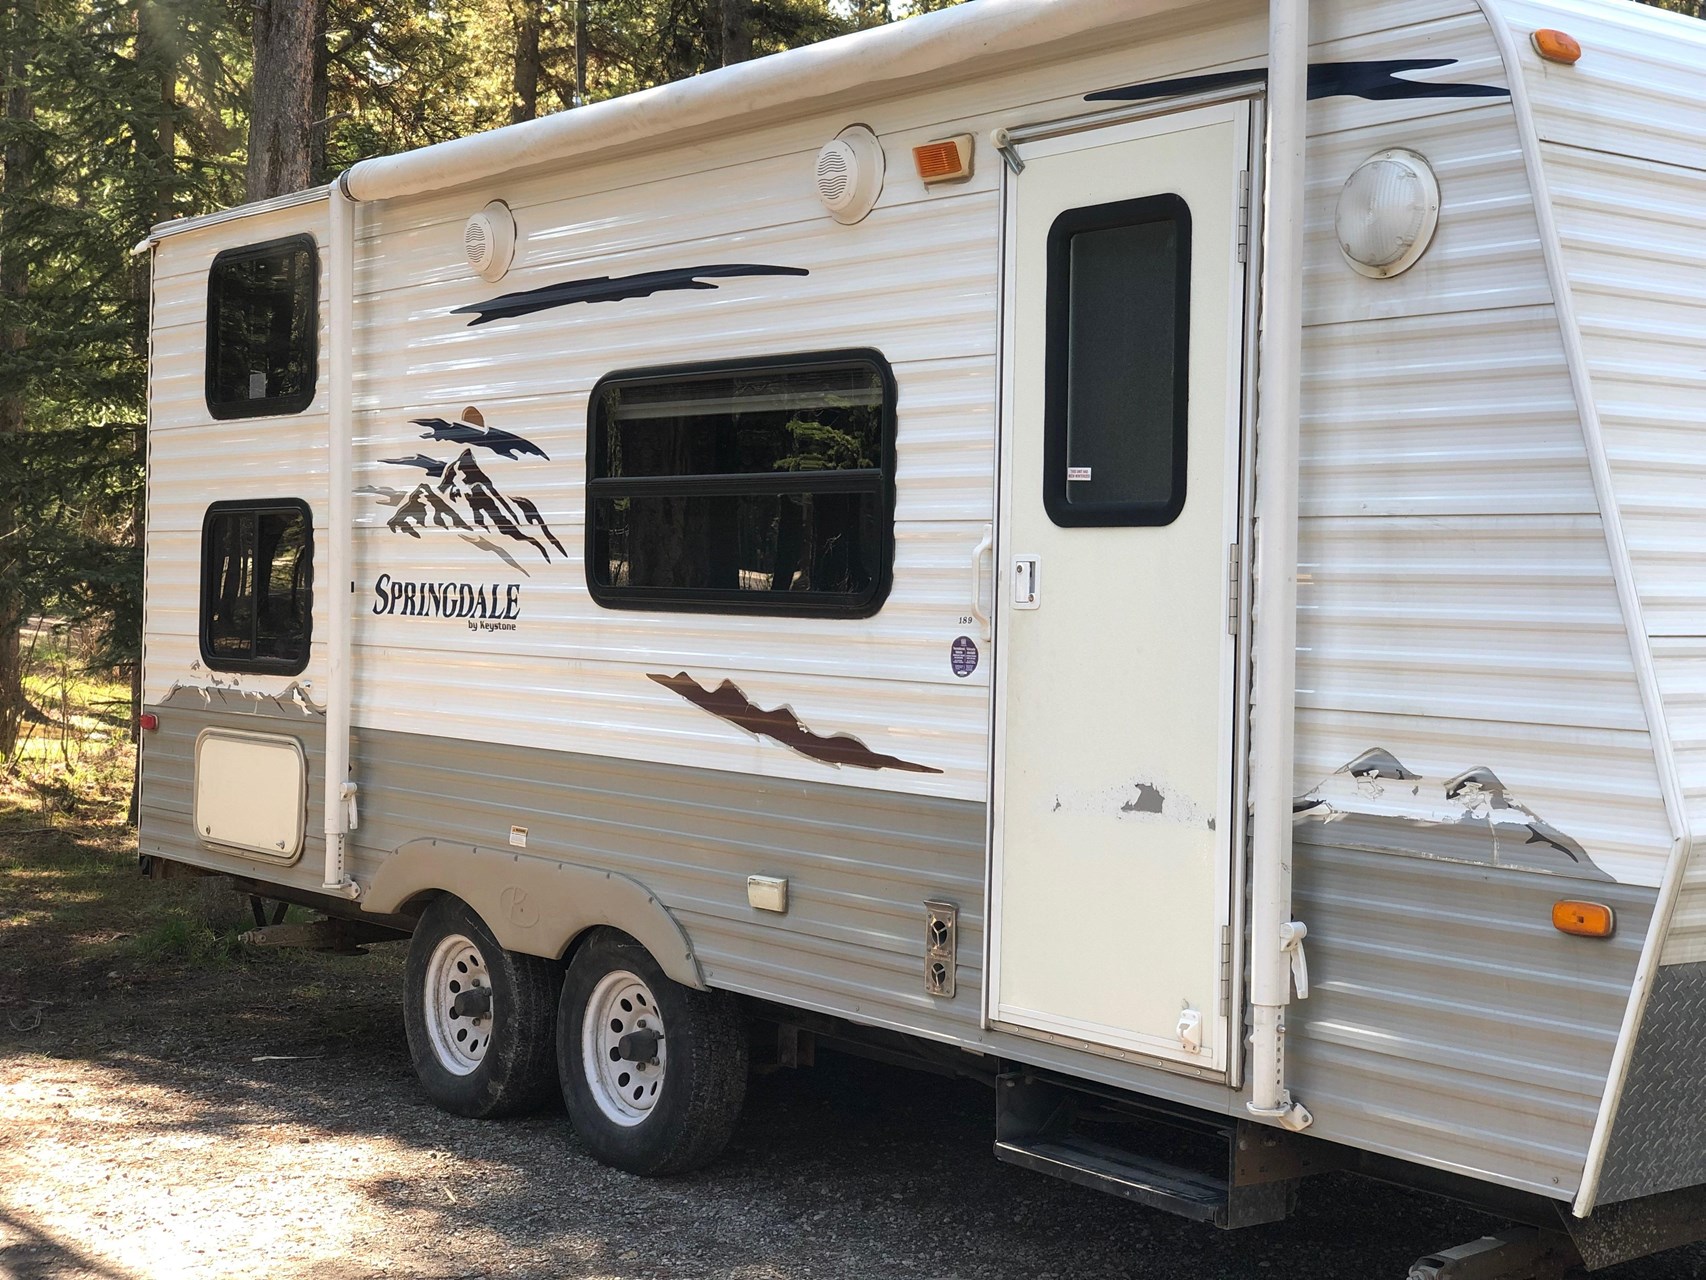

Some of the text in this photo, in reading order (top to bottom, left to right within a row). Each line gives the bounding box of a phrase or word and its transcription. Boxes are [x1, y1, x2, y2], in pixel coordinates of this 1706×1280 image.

[372, 573, 521, 620] SPRINGDALE
[468, 620, 516, 632] by Keystone
[958, 616, 973, 625] 189
